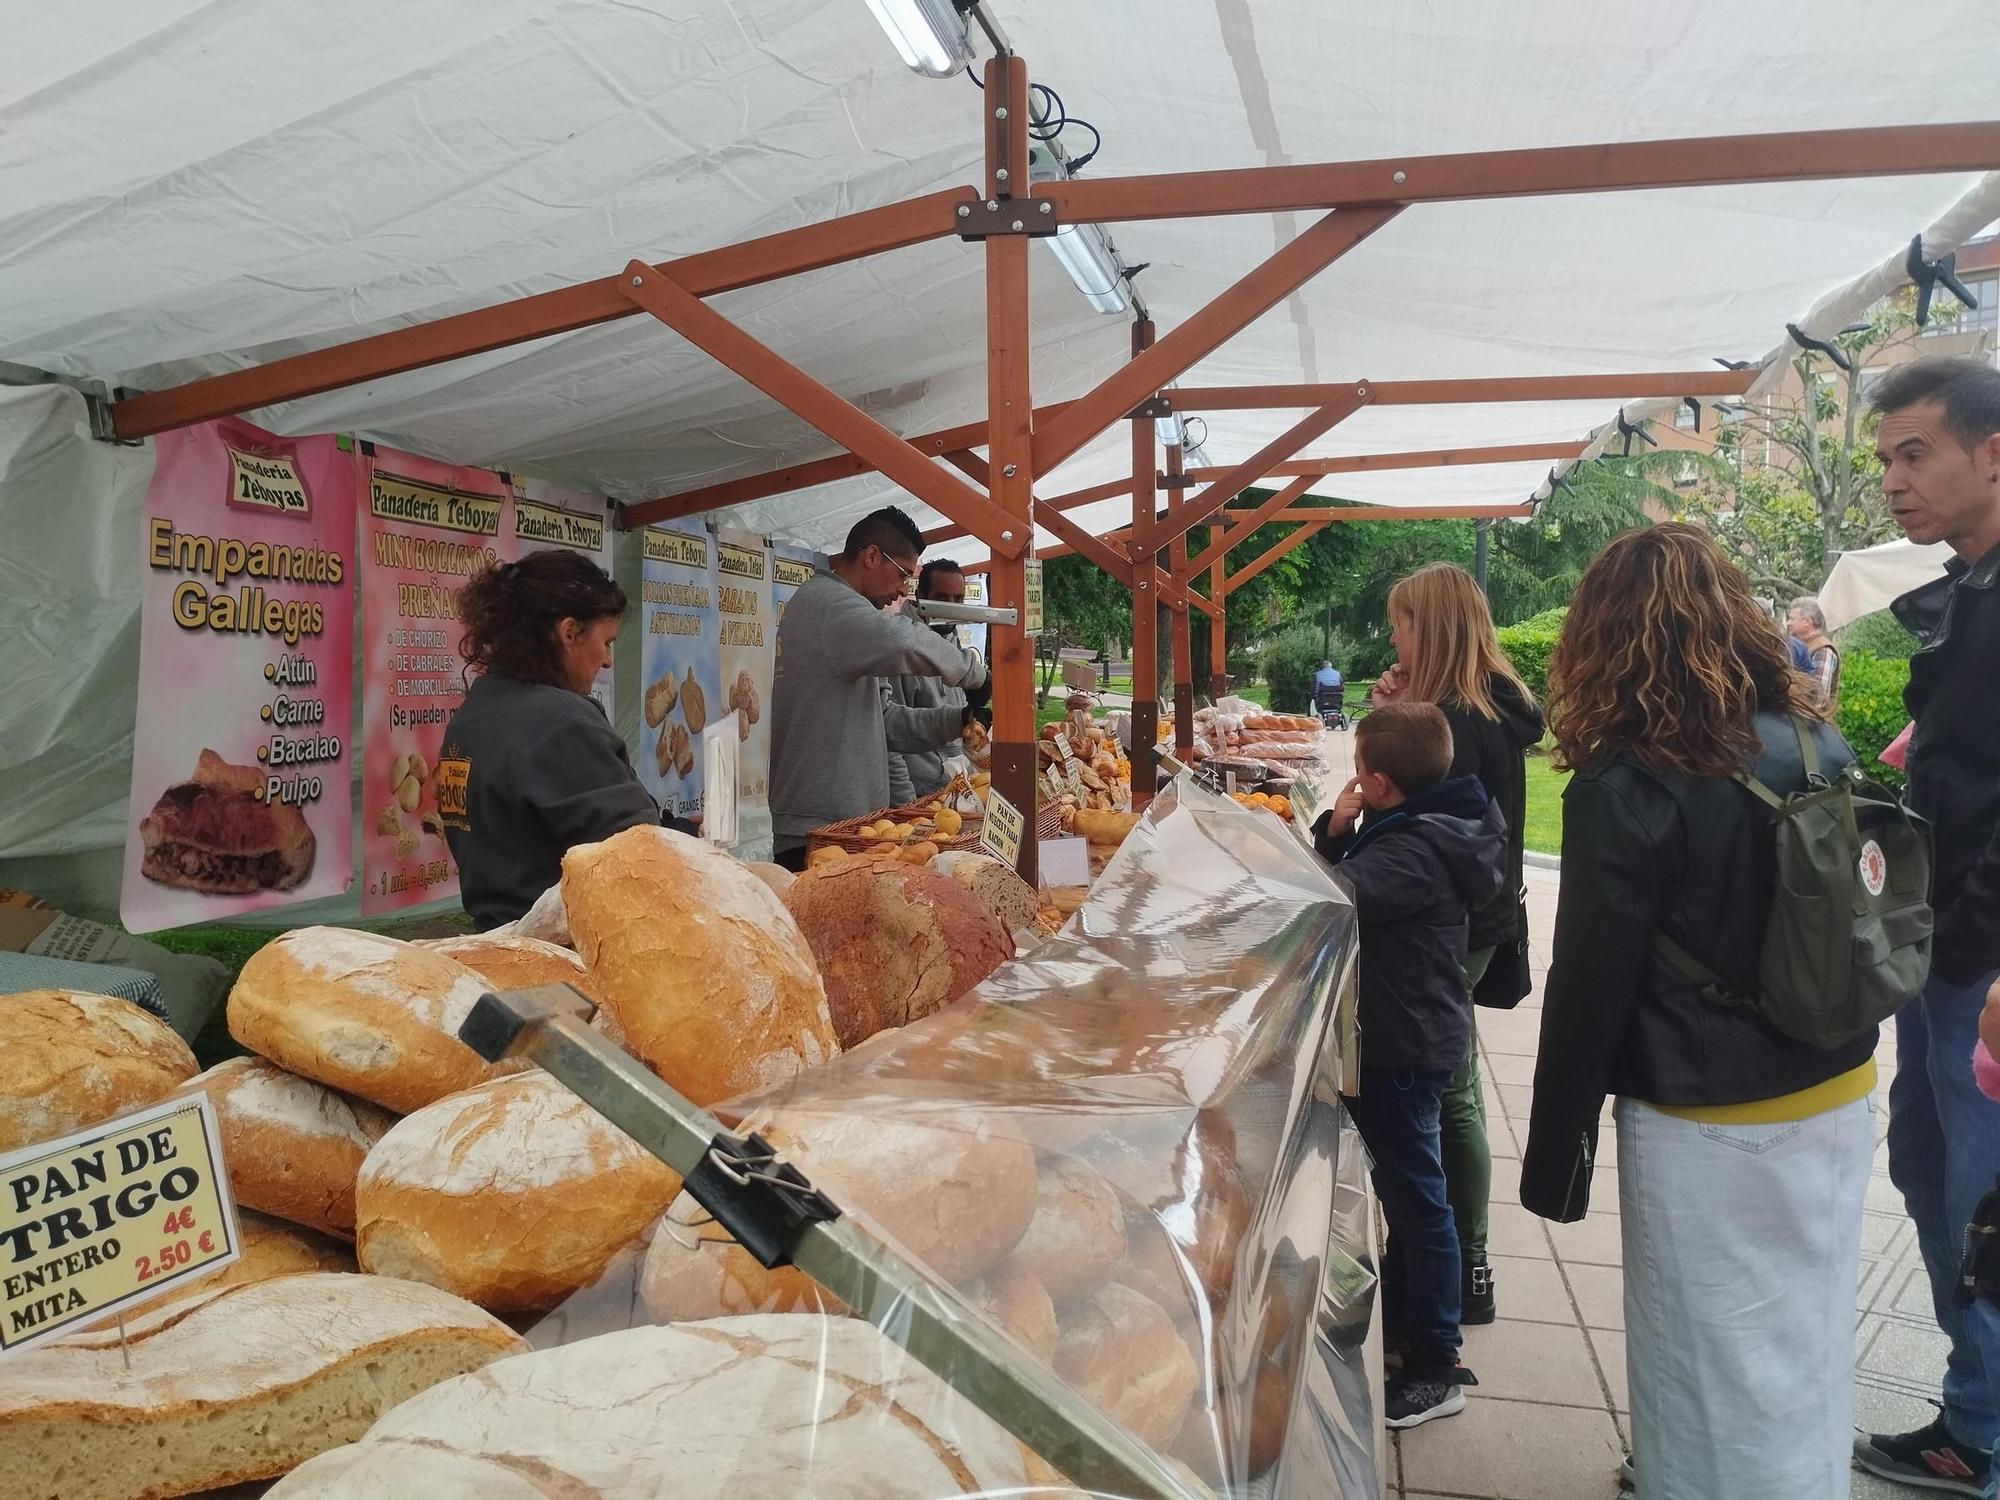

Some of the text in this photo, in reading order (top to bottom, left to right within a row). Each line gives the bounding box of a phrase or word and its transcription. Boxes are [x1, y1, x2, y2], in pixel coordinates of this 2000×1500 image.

[240, 474, 305, 510] Teboyas
[374, 531, 412, 570] MINI
[565, 518, 600, 548] Teboyas
[150, 517, 344, 587] Empanadas
[172, 580, 324, 647] Gallegas
[395, 629, 448, 649] DE CHORIZO
[274, 653, 316, 685] Atún
[396, 653, 454, 673] DE CABRALES
[397, 679, 410, 697] DE
[273, 694, 324, 725] Carne
[409, 704, 446, 731] pueden
[269, 731, 341, 766] Bacalao
[265, 773, 321, 808] Pulpo
[679, 799, 700, 814] GRANDE
[997, 803, 1016, 827] PAN DE
[9, 1126, 178, 1214] PAN DE
[0, 1166, 200, 1264] TRIGO
[2, 1205, 196, 1301] ENTERO 4€
[135, 1230, 215, 1282] 2.50 €
[10, 1286, 88, 1334] MITA
